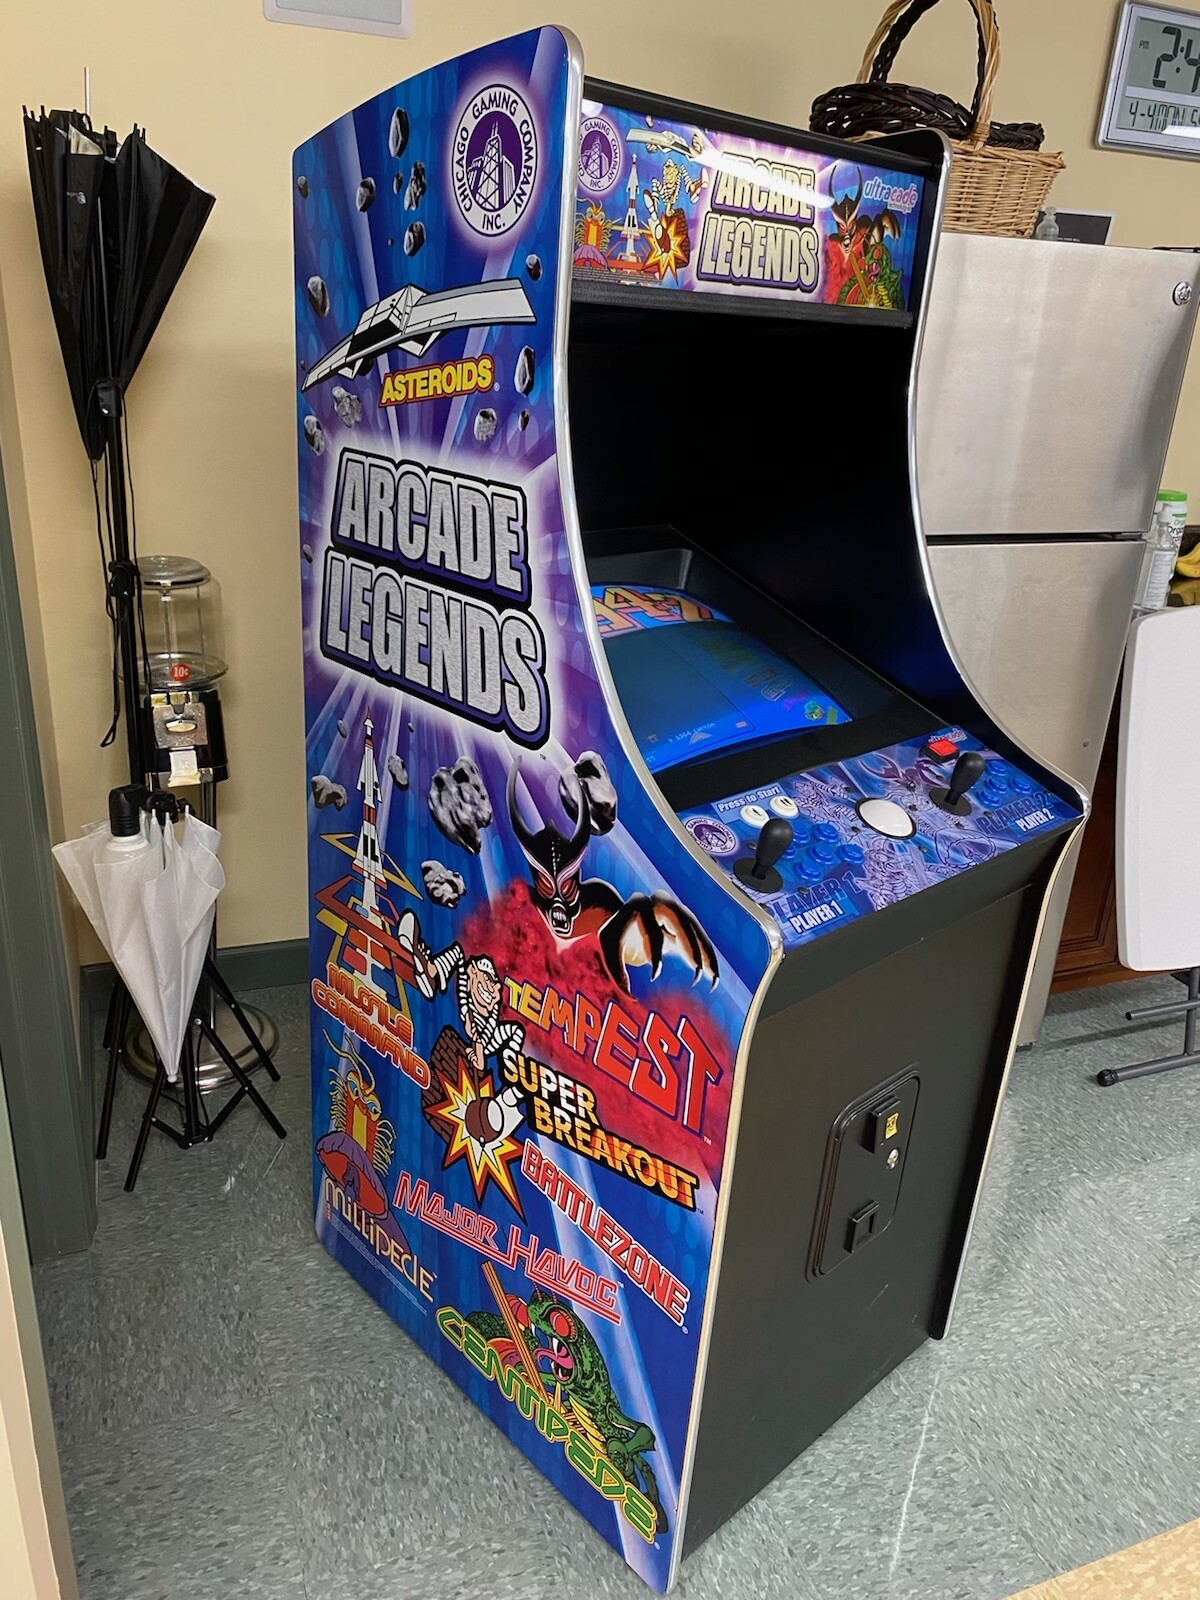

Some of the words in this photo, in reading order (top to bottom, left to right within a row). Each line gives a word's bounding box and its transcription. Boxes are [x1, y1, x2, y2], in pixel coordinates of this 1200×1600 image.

[472, 92, 518, 118] GAMING
[585, 120, 611, 136] GAMING
[455, 126, 473, 212] CHICAGO
[515, 119, 533, 214] COMPANY
[607, 138, 618, 182] COMPANY
[482, 213, 506, 230] INC.
[699, 213, 818, 289] LEGENDS
[380, 356, 495, 405] ASTEROIDS
[336, 456, 527, 598] ARCADE
[324, 553, 544, 737] LEGENDS
[717, 798, 746, 812] Press
[745, 794, 757, 803] to
[756, 786, 780, 799] Start
[1015, 810, 1049, 832] PLAYER
[1041, 807, 1055, 820] 2
[789, 903, 836, 934] PLAYER
[831, 900, 844, 915] 1
[312, 979, 431, 1089] COMMAND
[328, 962, 413, 1049] MISSILE
[504, 976, 723, 1136] TEMPEST
[504, 1050, 600, 1125] SUPER
[534, 1098, 698, 1209] BREAKOUT
[393, 1171, 500, 1251] MAJOR
[507, 1225, 622, 1323] HAVOC
[522, 1138, 690, 1327] BATTLEZONE
[437, 1307, 657, 1544] CENTIPEDE
